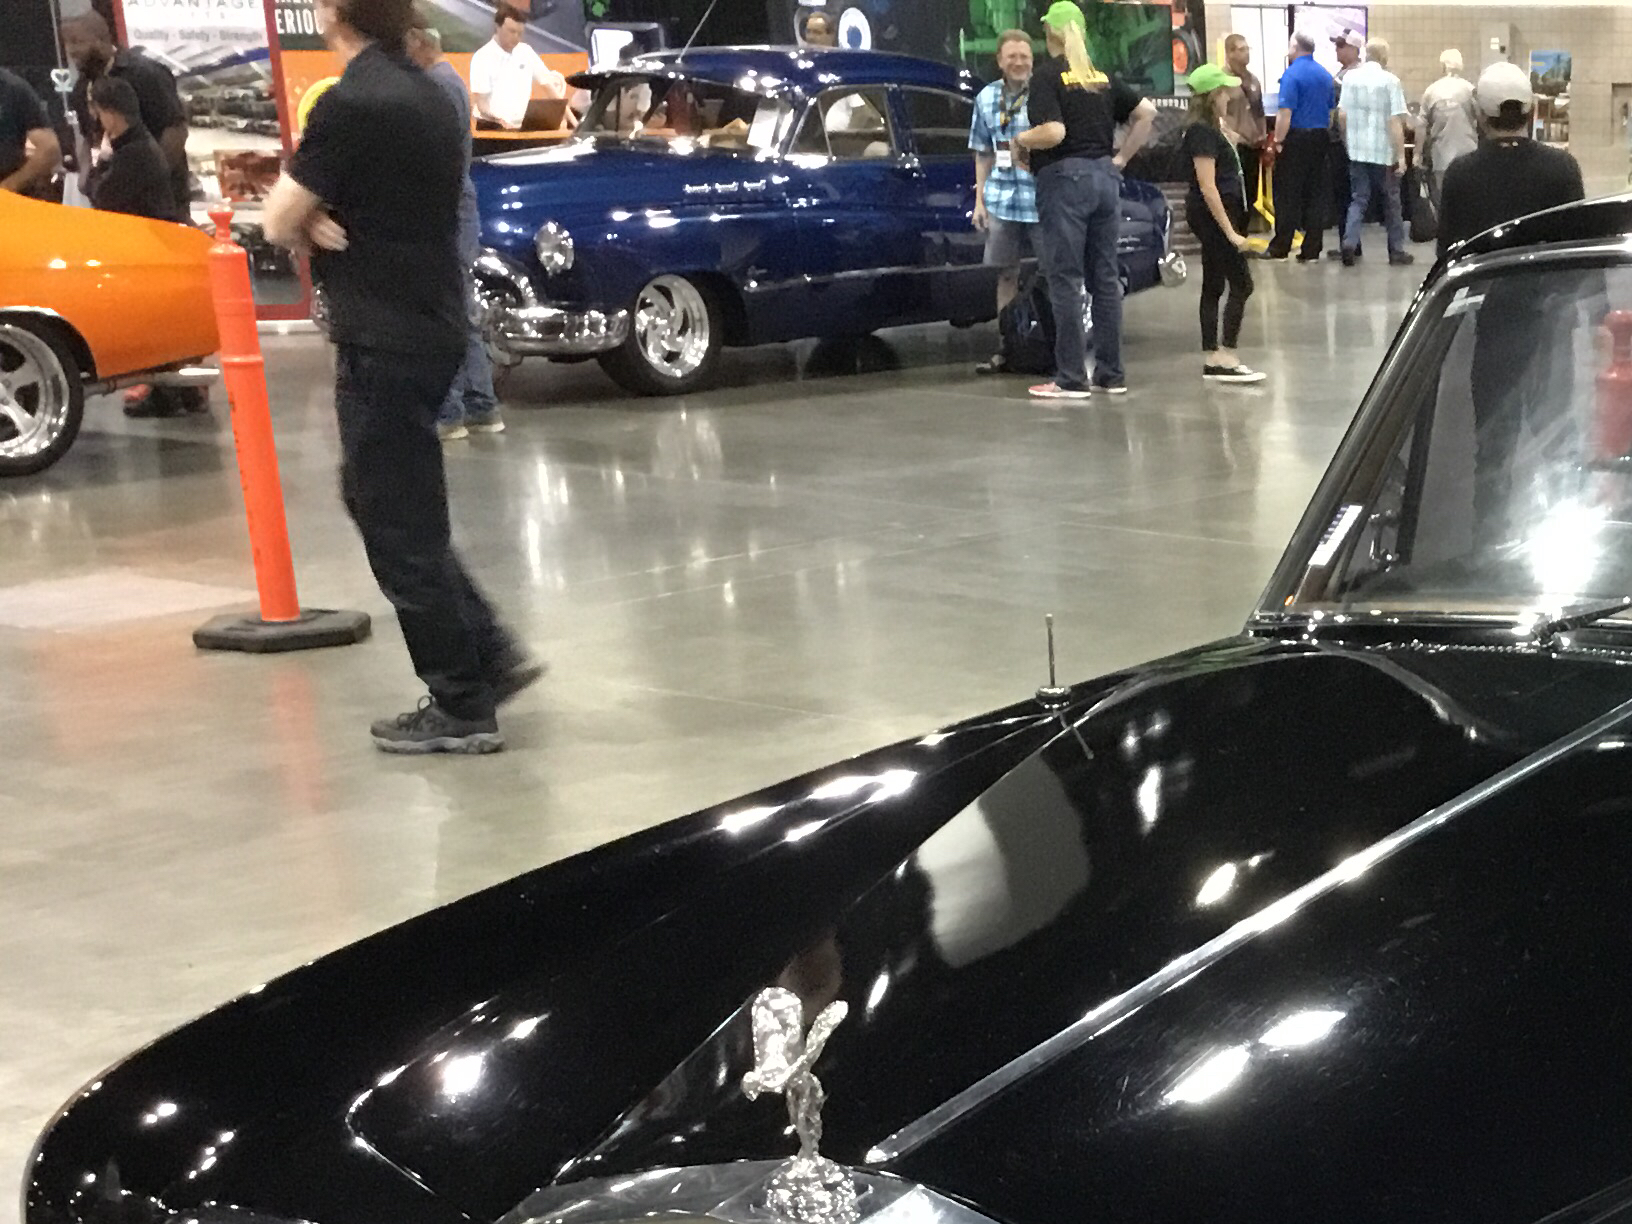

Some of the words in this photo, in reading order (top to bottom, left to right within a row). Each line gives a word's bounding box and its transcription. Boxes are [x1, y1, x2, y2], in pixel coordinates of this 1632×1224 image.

[274, 8, 325, 35] ERIOU
[133, 28, 169, 42] Quality
[178, 29, 210, 42] Safety
[219, 29, 262, 42] Strength
